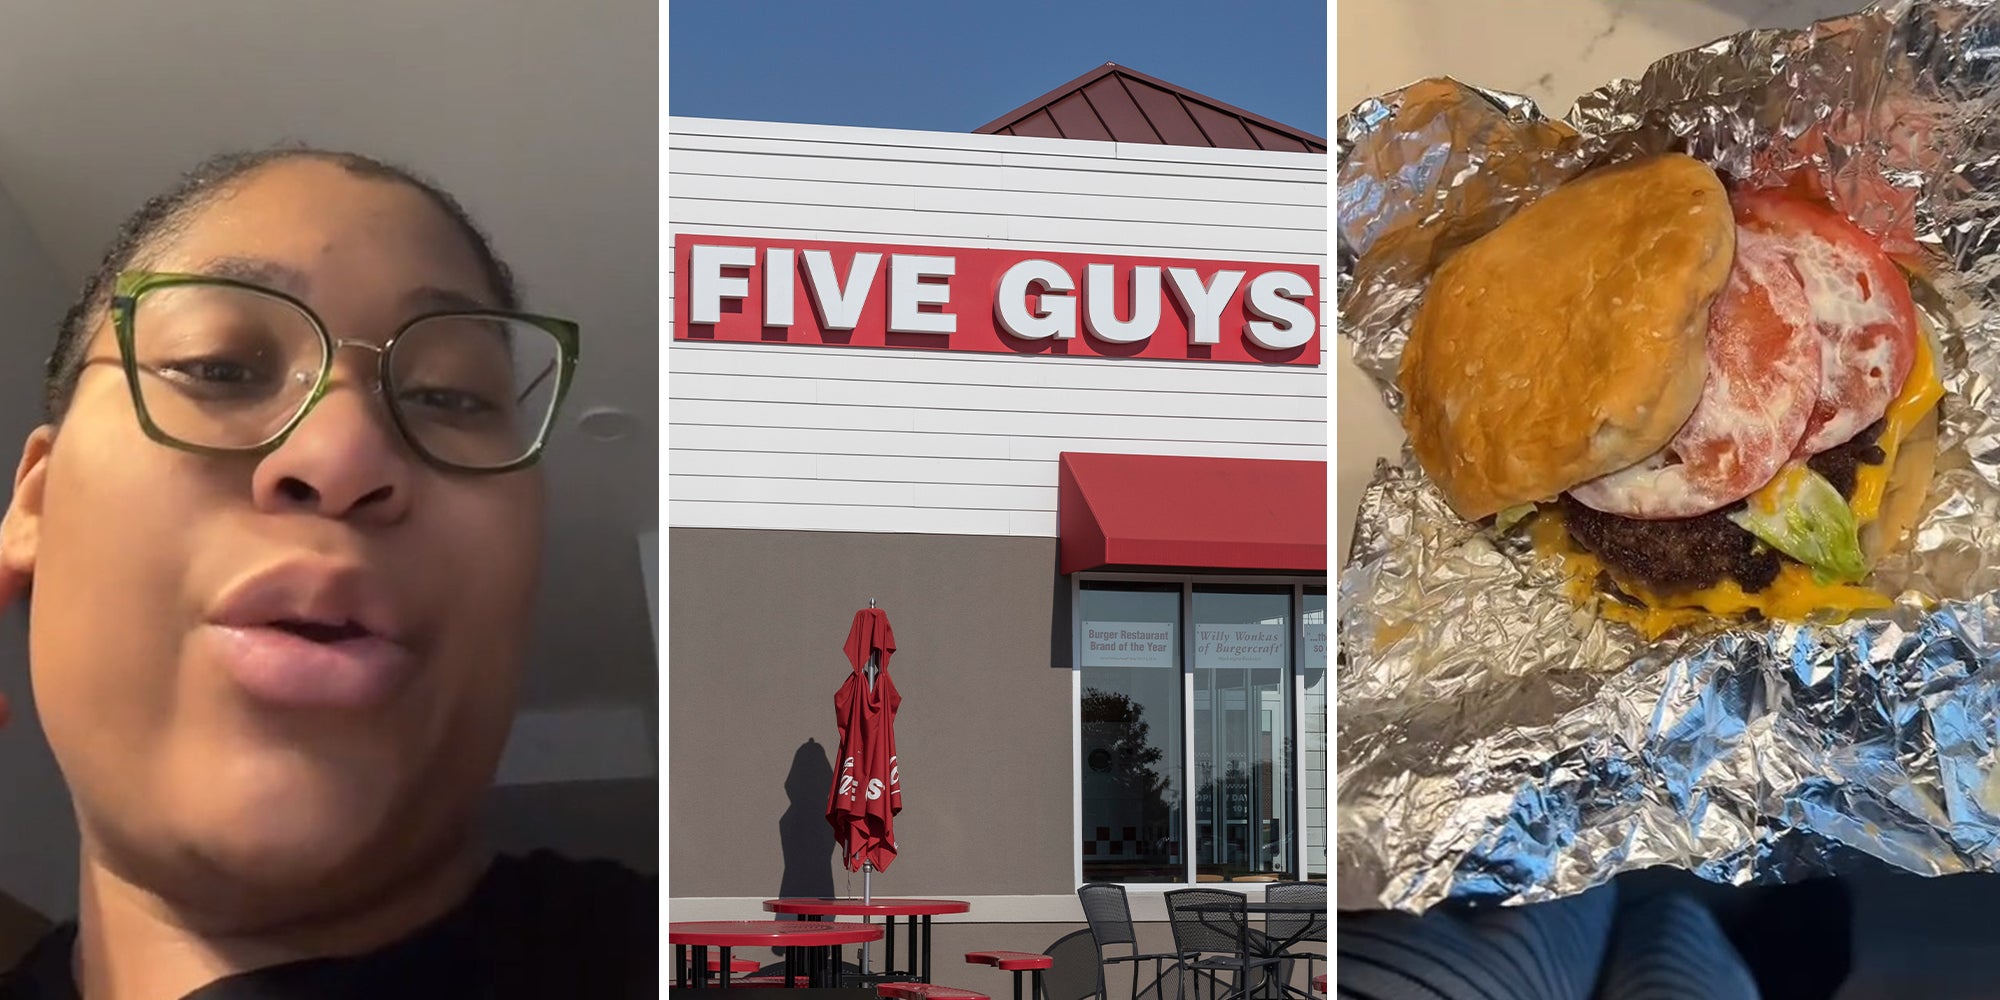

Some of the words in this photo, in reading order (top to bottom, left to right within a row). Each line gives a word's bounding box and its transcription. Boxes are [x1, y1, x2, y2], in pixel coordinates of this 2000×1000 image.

[690, 244, 957, 333] FIVE
[996, 258, 1318, 350] GUYS
[1088, 629, 1118, 641] Burger
[1120, 630, 1169, 641] Restaurant
[1090, 641, 1116, 651] Brand
[1118, 642, 1128, 651] of
[1130, 642, 1145, 652] the
[1147, 642, 1167, 653] Year
[1198, 642, 1211, 656] of
